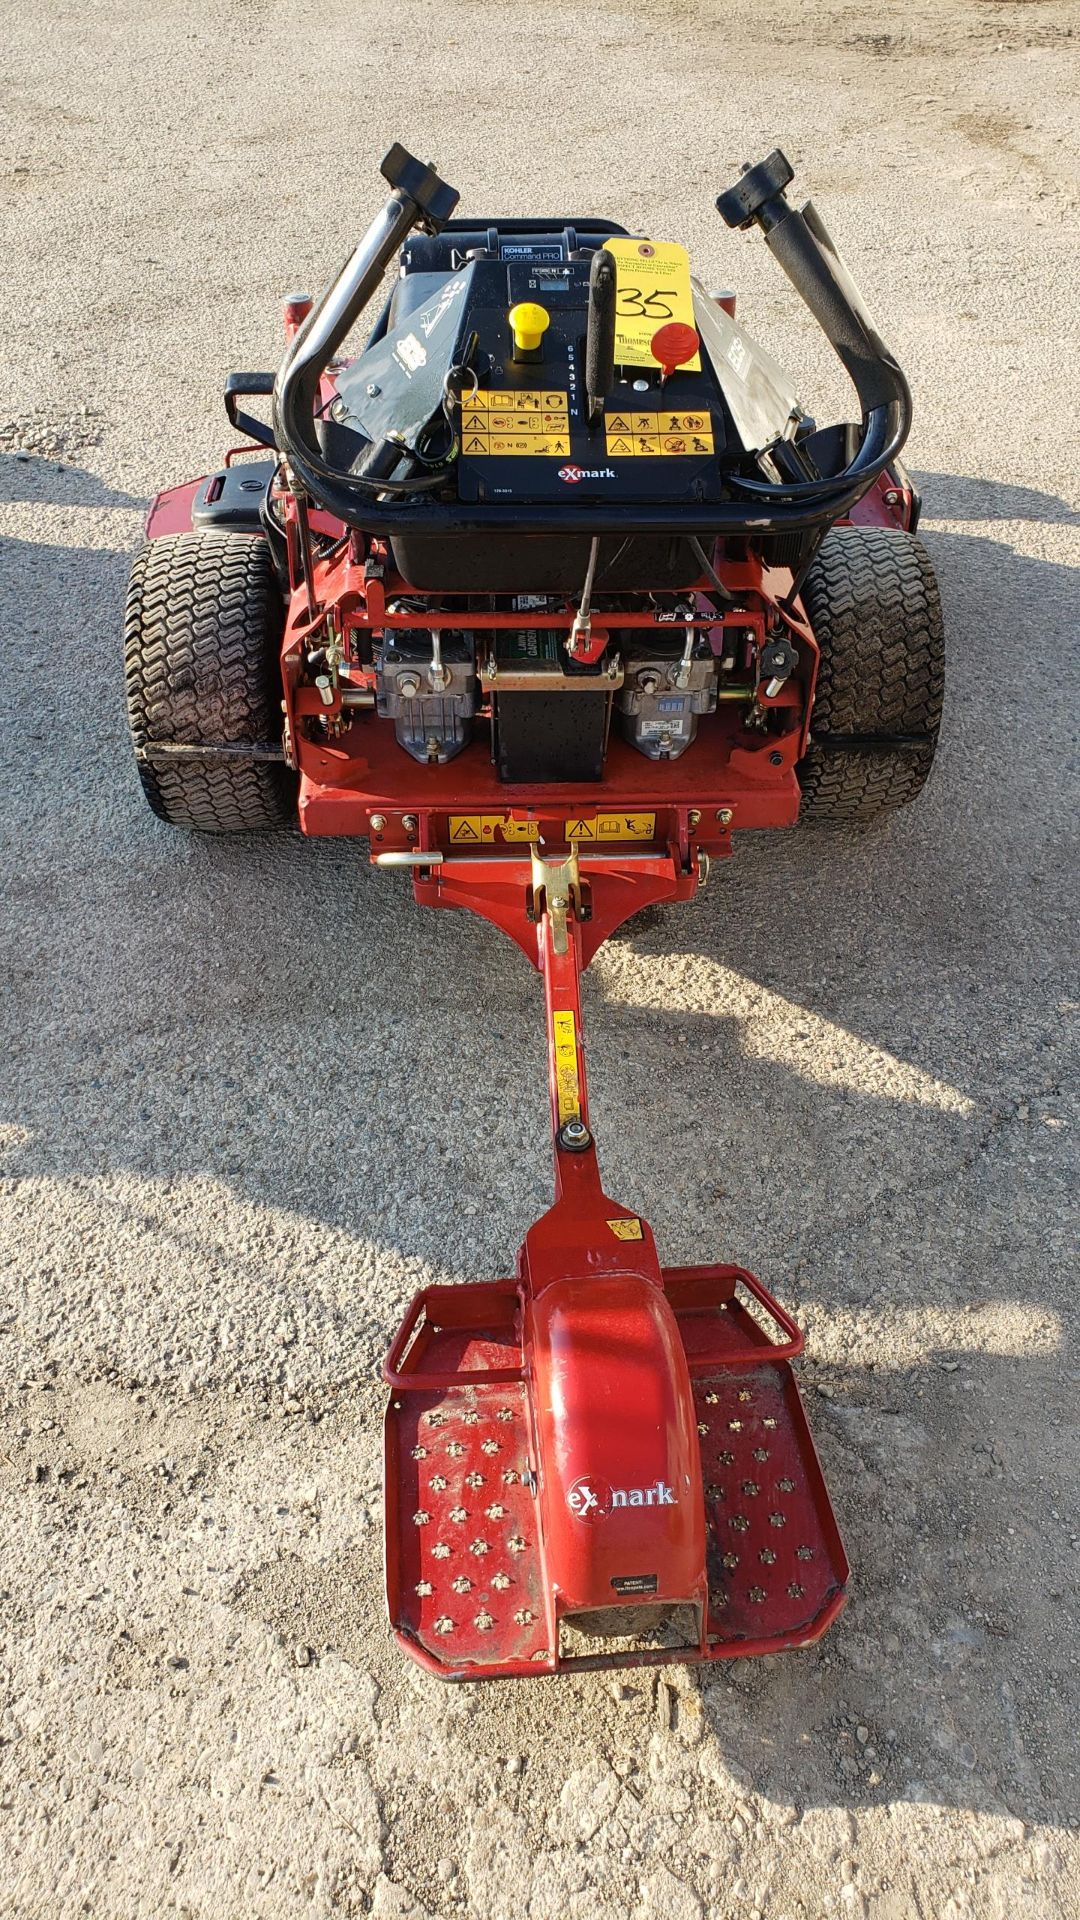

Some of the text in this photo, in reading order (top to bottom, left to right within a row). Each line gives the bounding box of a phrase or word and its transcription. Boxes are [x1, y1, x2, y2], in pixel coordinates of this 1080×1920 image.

[504, 252, 560, 260] Command PRO
[616, 288, 678, 319] 35
[569, 373, 576, 381] 3
[569, 383, 576, 391] 2
[570, 393, 576, 401] 1
[570, 408, 579, 416] N
[558, 468, 616, 481] eXmark
